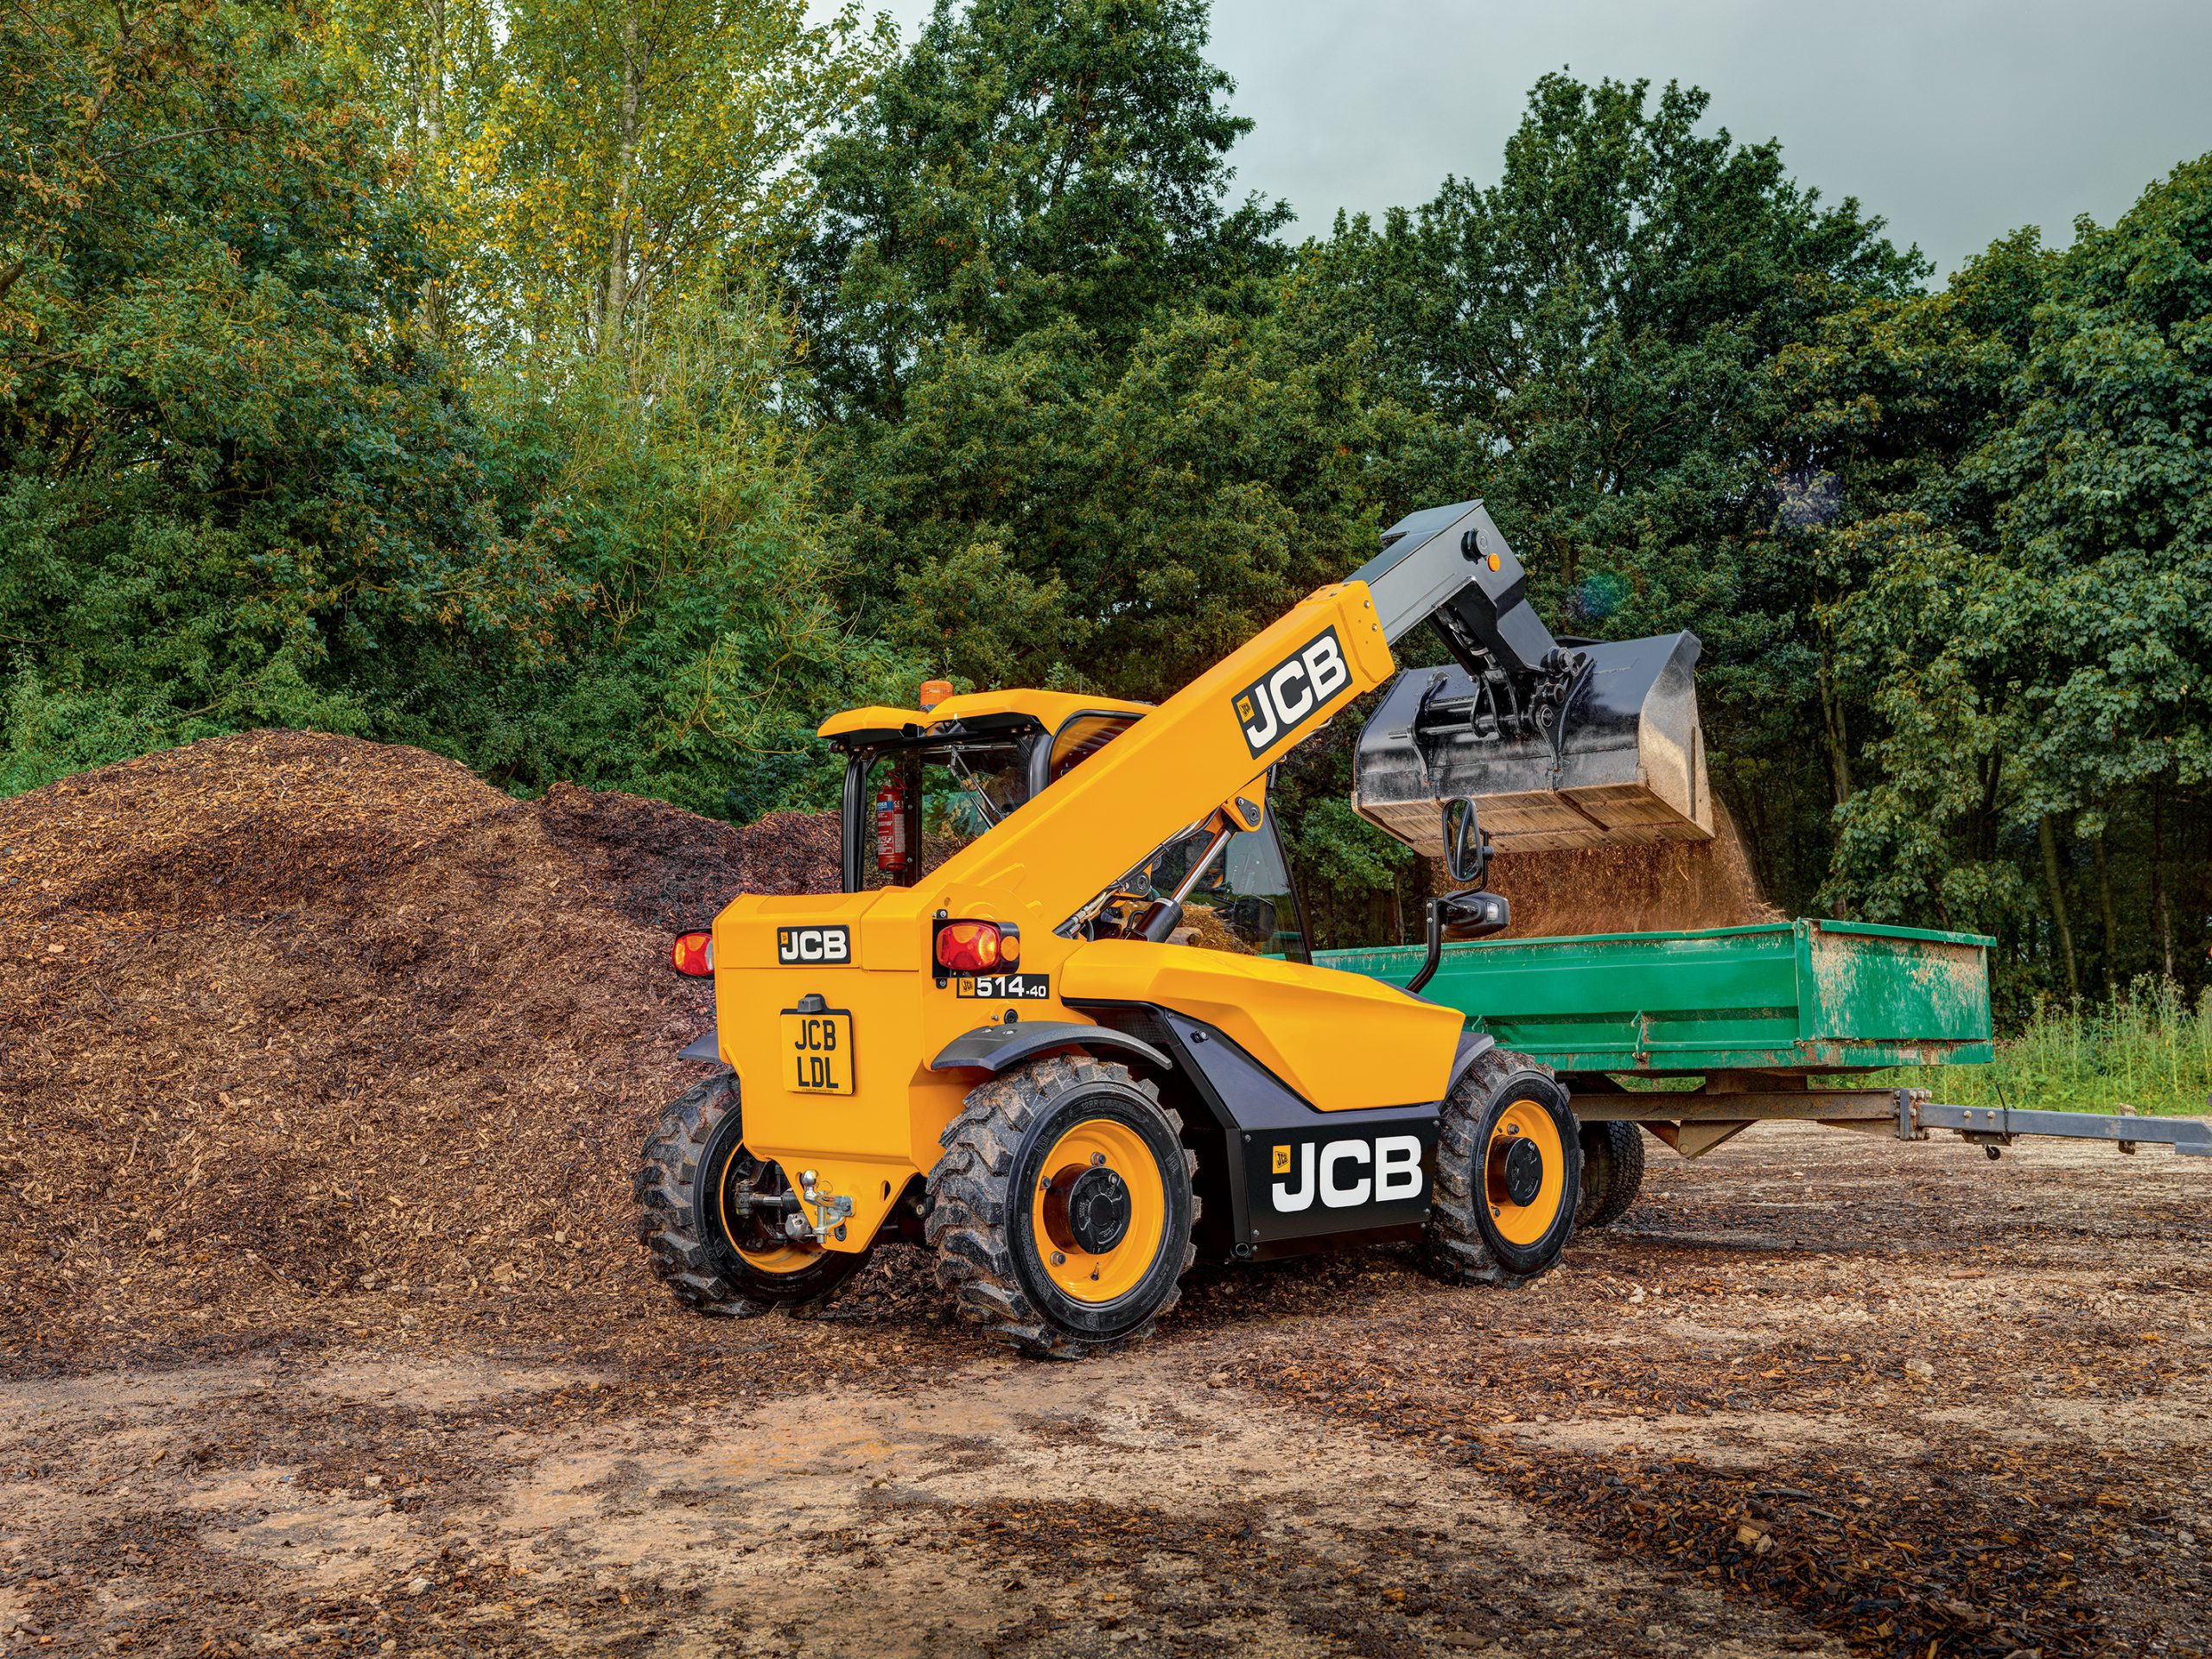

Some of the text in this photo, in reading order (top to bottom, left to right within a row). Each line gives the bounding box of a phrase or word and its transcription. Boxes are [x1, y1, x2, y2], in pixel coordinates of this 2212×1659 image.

[1246, 635, 1347, 748] JCB
[781, 930, 848, 960] JCB
[794, 1019, 836, 1051] JCB
[797, 1056, 839, 1089] LDL
[1272, 1135, 1423, 1213] JCB
